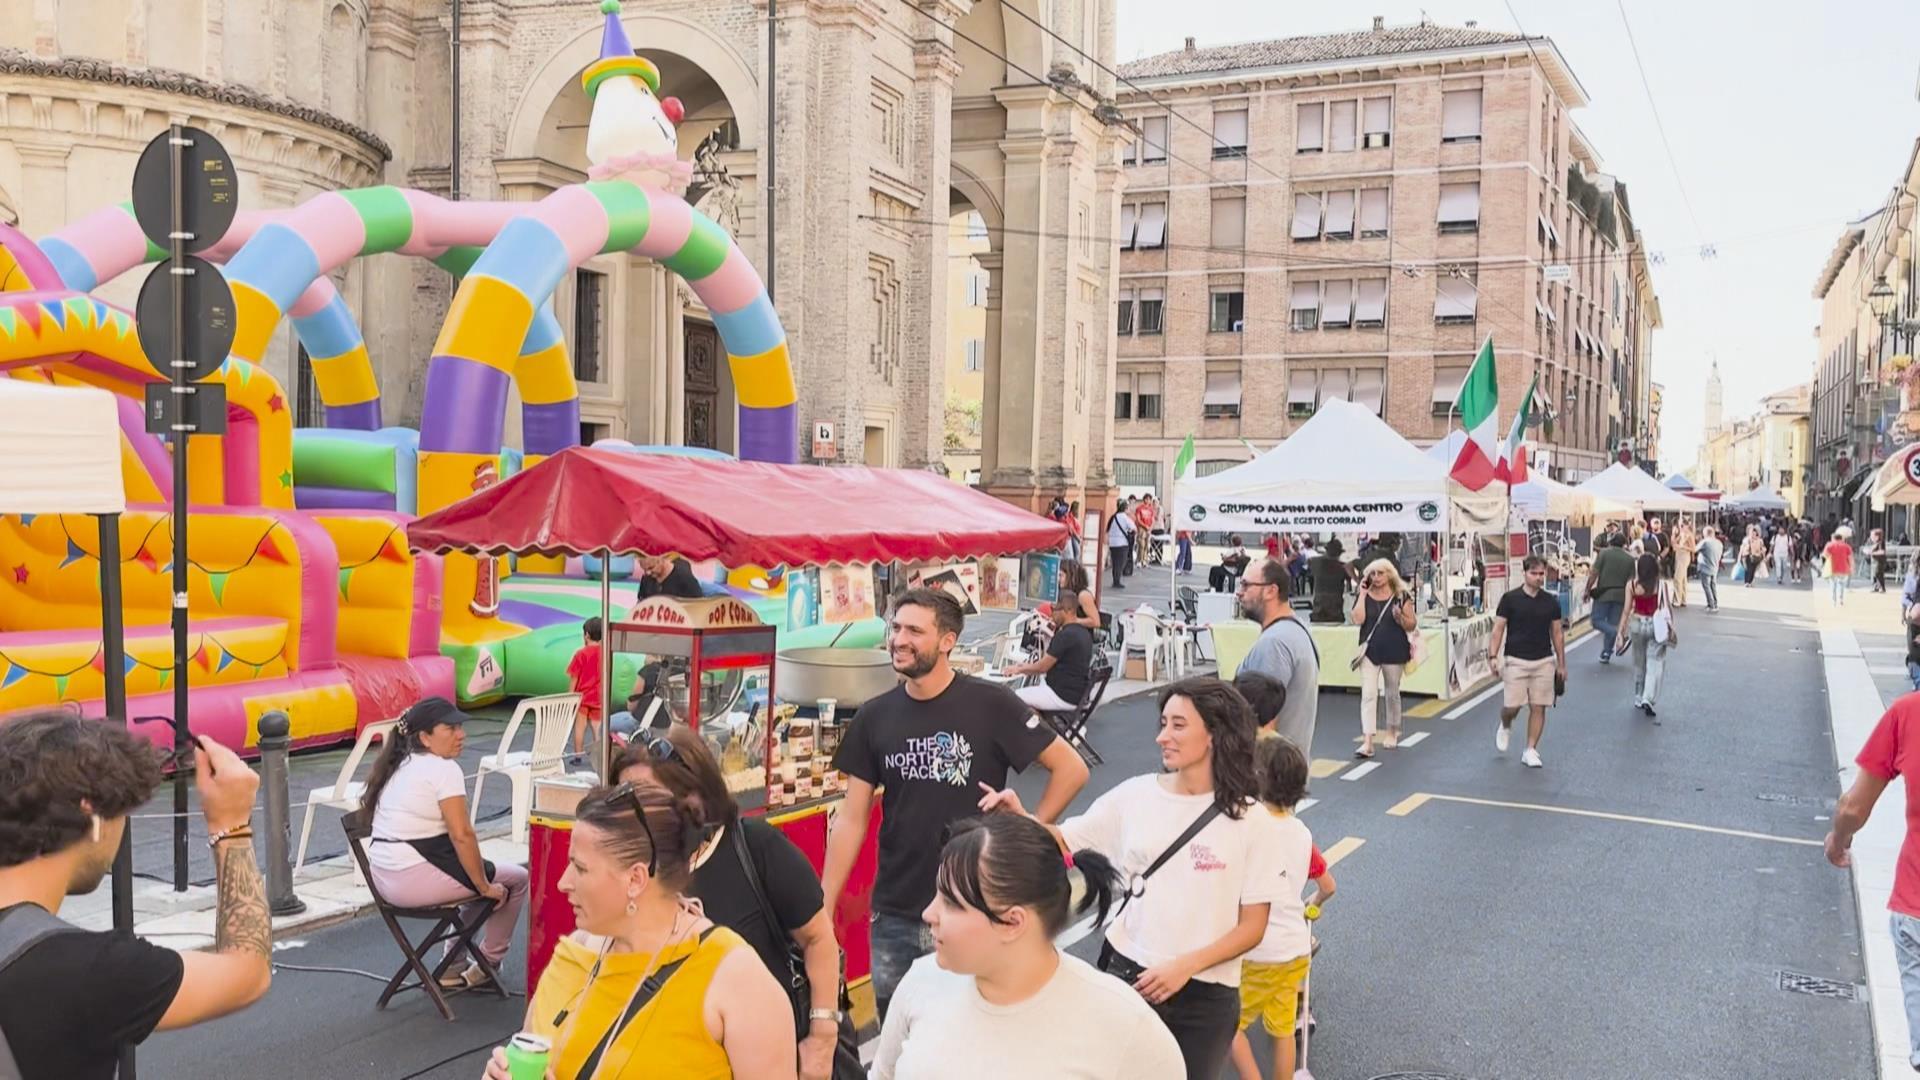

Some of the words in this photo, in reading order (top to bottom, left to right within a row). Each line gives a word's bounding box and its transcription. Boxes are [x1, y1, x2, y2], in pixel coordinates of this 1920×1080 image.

[1218, 503, 1265, 514] GRUPPO
[1267, 504, 1306, 513] ALPINI
[1307, 504, 1351, 513] PARMA
[1353, 502, 1403, 513] CENTRO
[1293, 517, 1325, 525] EGISTO
[1326, 516, 1366, 525] CORRADI
[632, 605, 654, 621] POP
[657, 604, 685, 624] CORN
[708, 603, 726, 624] POP
[728, 600, 753, 624] CORN
[906, 737, 937, 752] THE
[885, 752, 936, 769] NORTH
[901, 765, 937, 780] FACE
